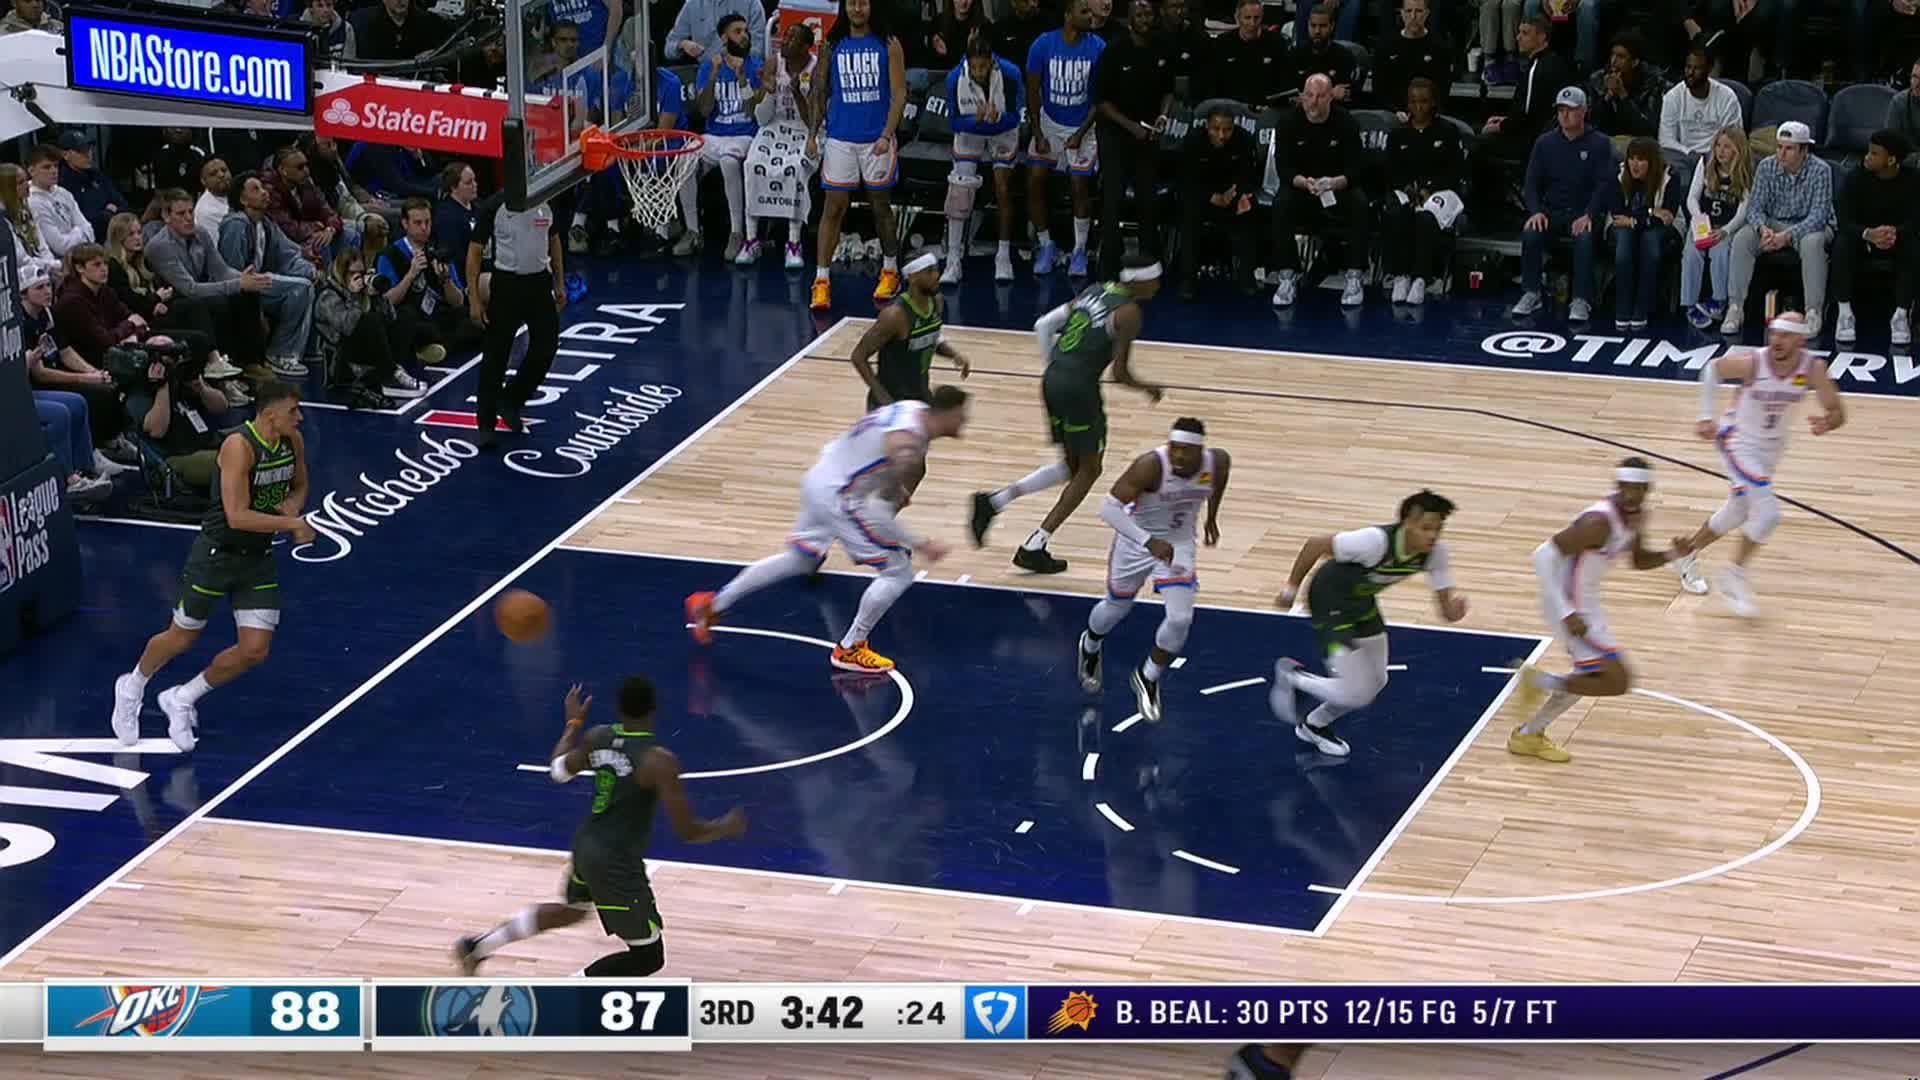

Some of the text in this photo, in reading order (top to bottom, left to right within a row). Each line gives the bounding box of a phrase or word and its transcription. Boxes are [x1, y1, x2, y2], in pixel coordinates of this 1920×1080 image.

[89, 27, 292, 101] NBAStore.com
[1711, 201, 1723, 216] 5
[1480, 331, 1920, 385] @TIMR
[503, 383, 683, 478] Courtside
[11, 476, 59, 535] League
[292, 431, 479, 562] Michelob
[16, 529, 50, 579] Pass
